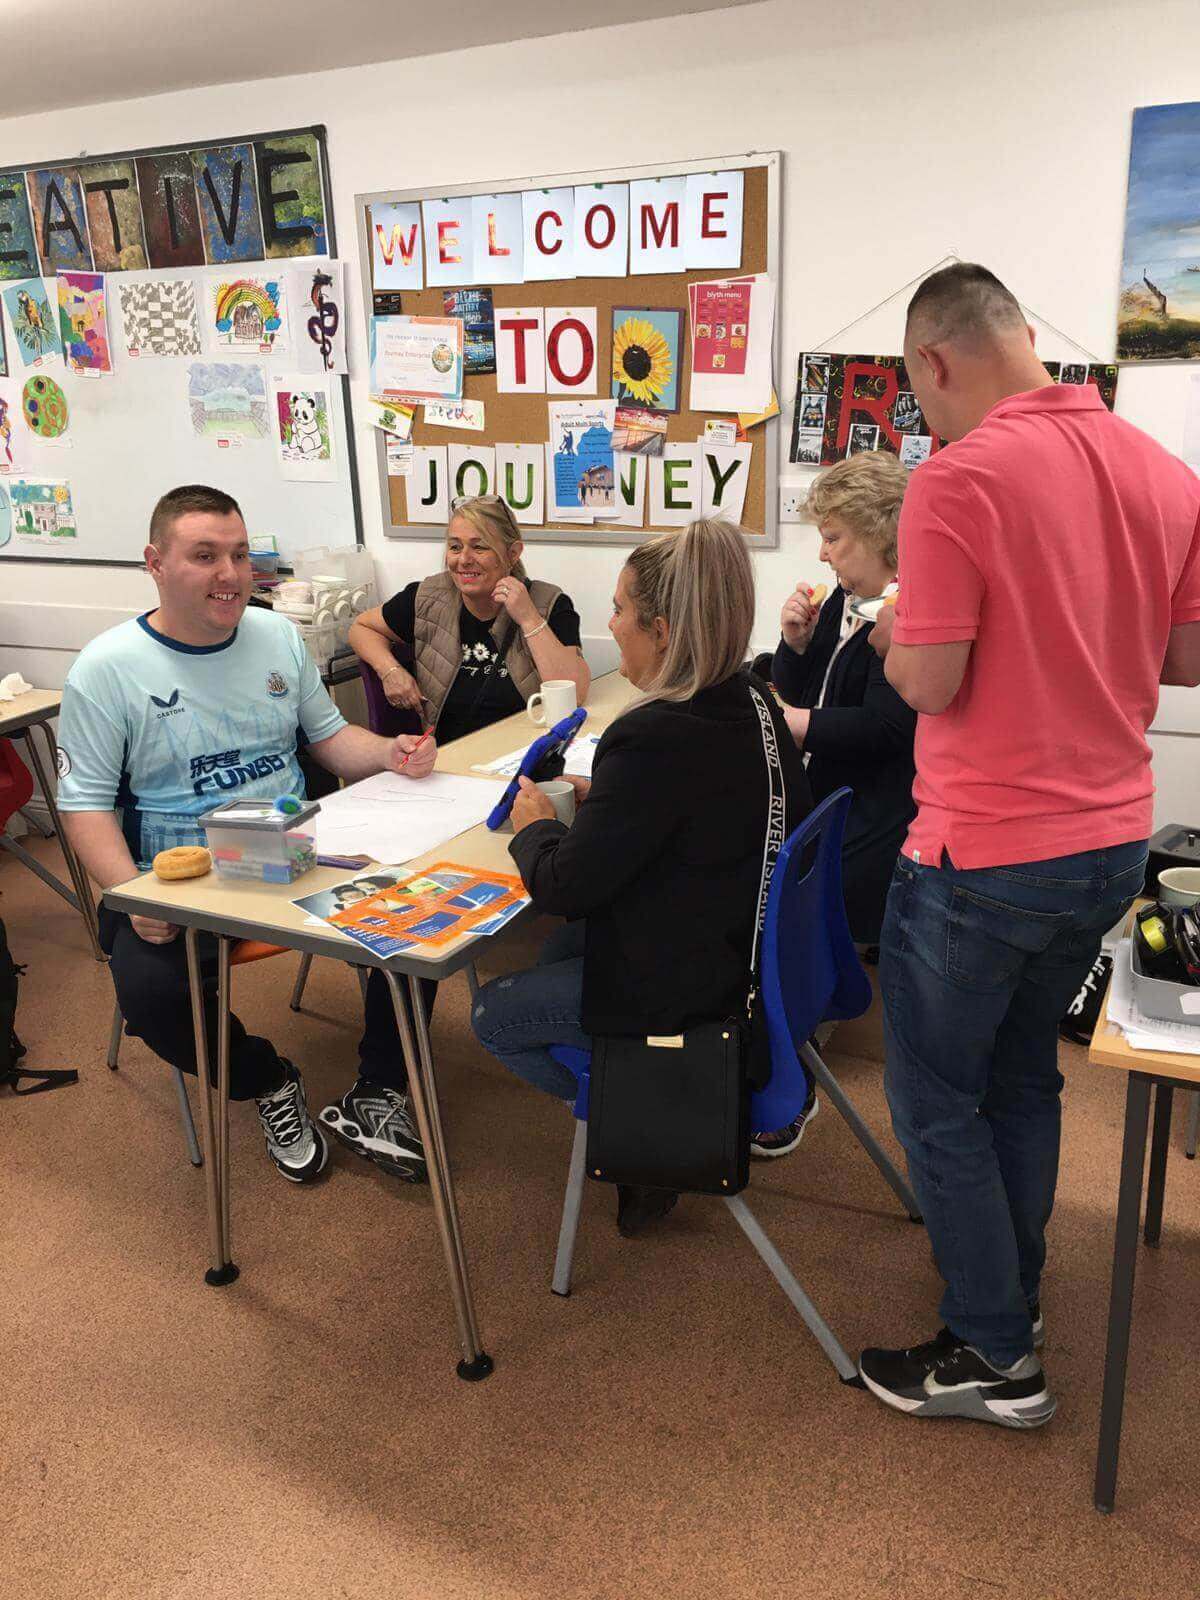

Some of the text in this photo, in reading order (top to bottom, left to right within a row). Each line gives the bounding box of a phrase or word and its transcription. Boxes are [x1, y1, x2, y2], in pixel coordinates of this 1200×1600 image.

[376, 192, 729, 265] WELCOME
[707, 291, 724, 299] blyth
[500, 318, 594, 386] TO
[420, 454, 743, 510] JOUNEY
[156, 707, 185, 719] CASTORE
[758, 704, 778, 768] ISLAND
[768, 795, 784, 853] RIVER
